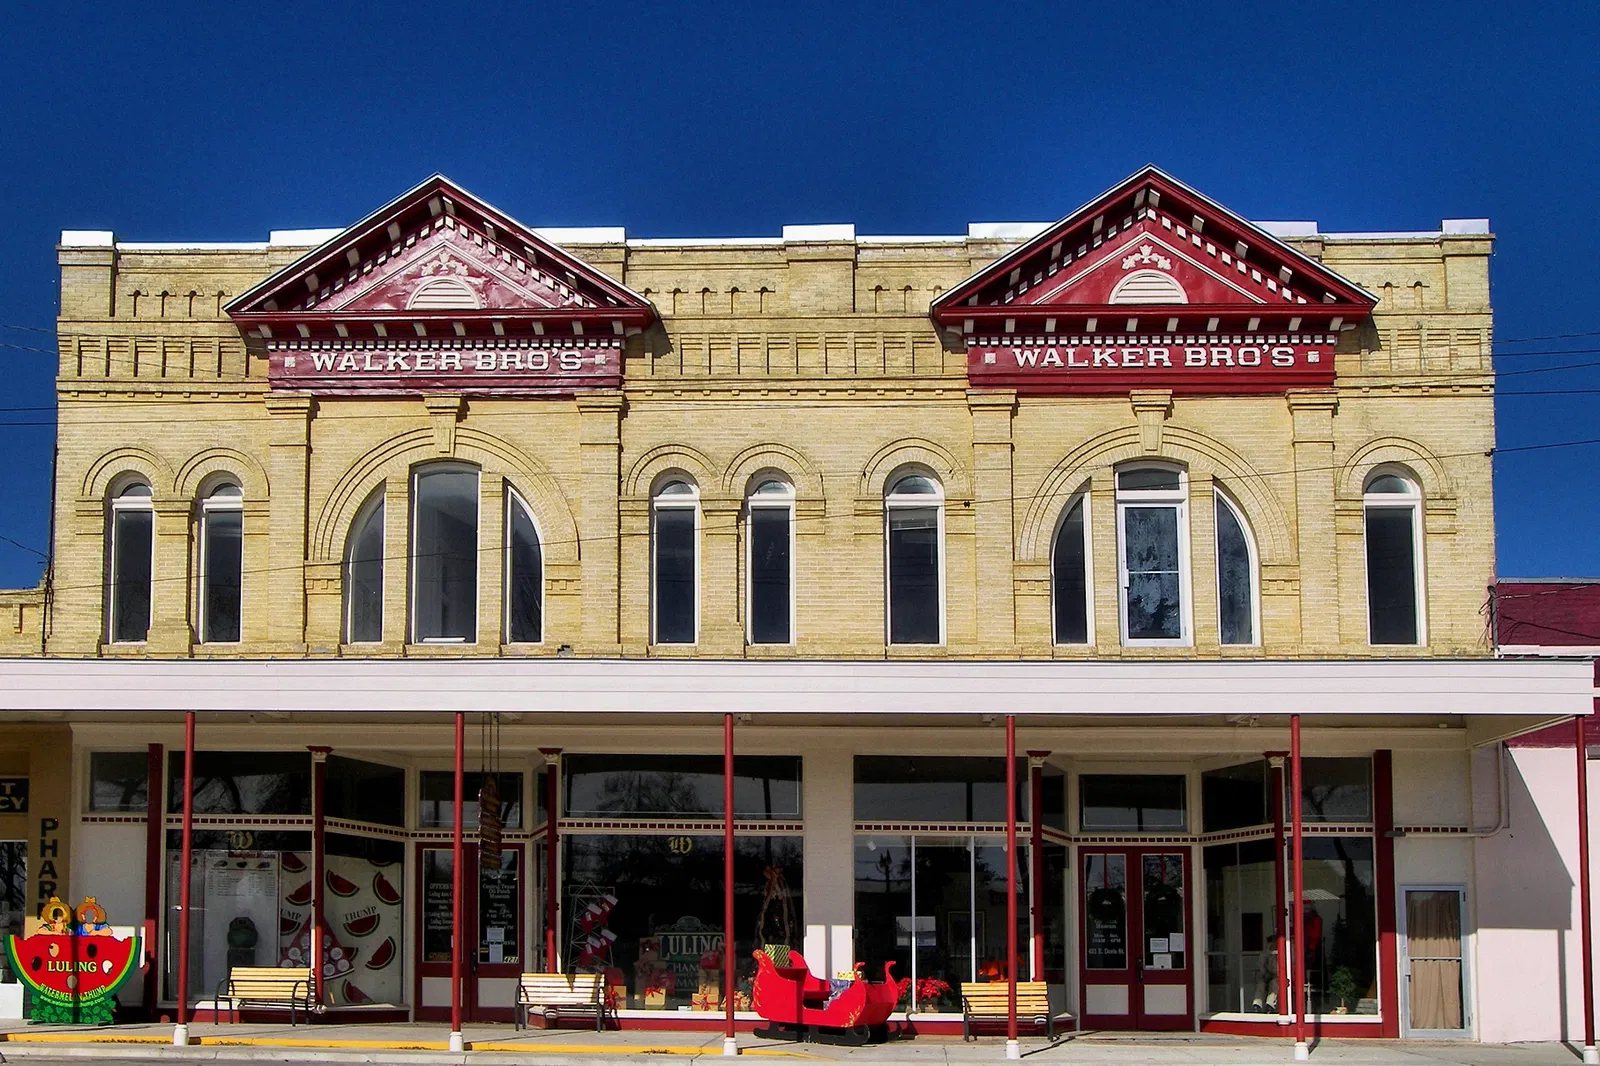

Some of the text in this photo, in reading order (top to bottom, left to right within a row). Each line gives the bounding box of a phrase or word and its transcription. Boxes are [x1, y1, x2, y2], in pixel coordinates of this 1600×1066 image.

[310, 348, 584, 373] WALKER BRO'S
[1012, 344, 1295, 368] WALKER BRO'S
[1, 782, 16, 795] T
[344, 905, 377, 922] THUMP
[47, 960, 97, 973] LULING
[84, 984, 106, 1001] THUMP
